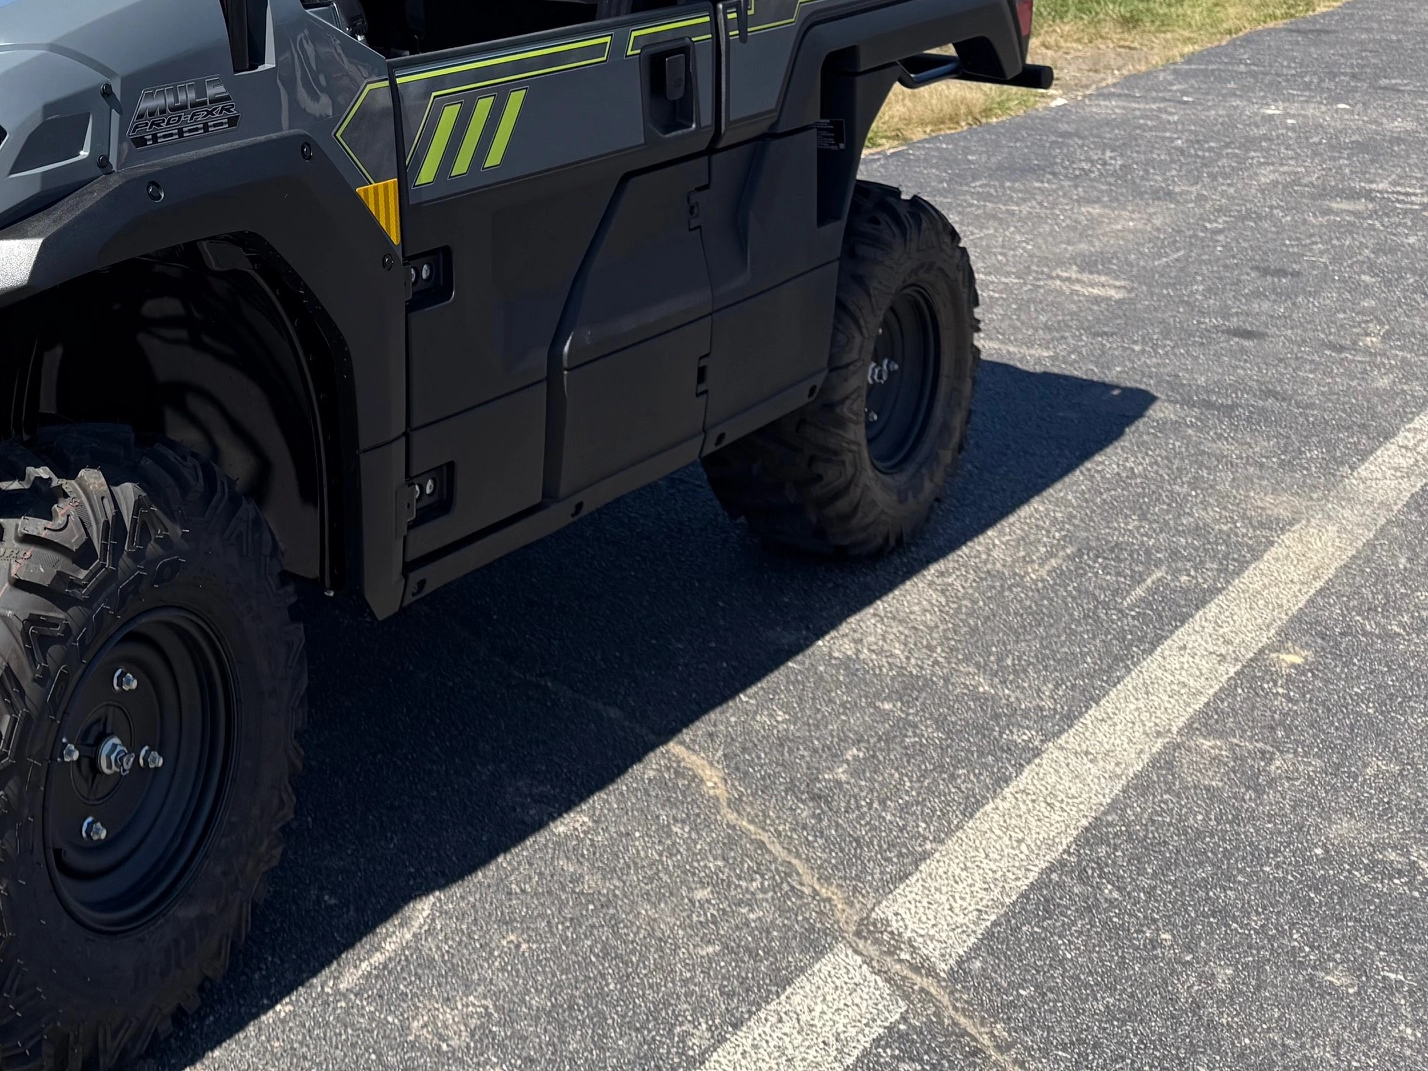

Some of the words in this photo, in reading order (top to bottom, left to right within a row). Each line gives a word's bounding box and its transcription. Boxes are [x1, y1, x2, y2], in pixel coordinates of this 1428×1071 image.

[135, 77, 233, 120] MULE
[130, 103, 239, 135] PRO-FXR
[144, 119, 229, 145] 1000
